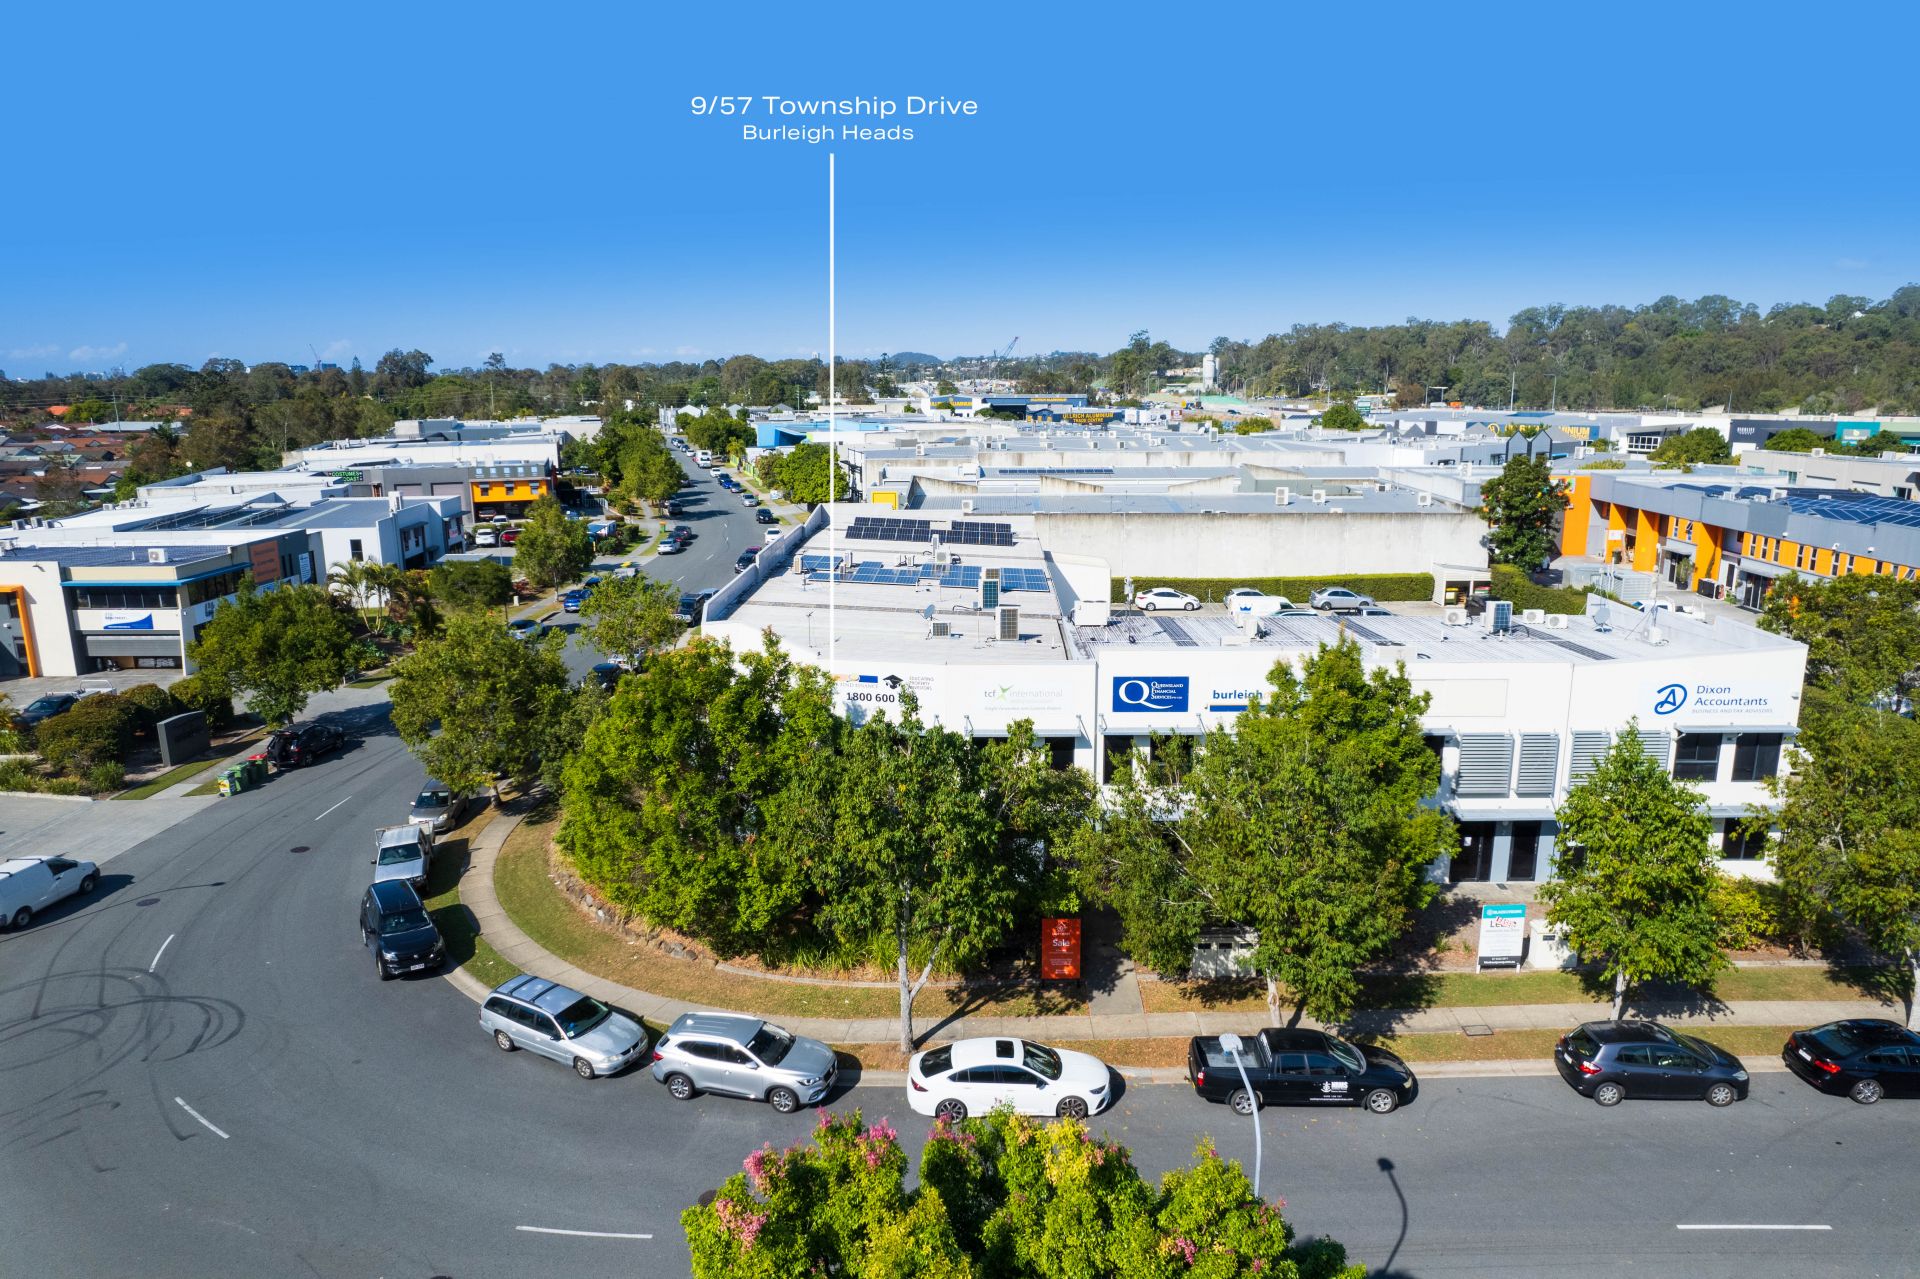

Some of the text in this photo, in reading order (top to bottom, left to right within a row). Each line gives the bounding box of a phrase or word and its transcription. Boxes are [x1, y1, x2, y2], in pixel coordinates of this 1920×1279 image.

[984, 688, 1063, 698] tcf international
[1696, 685, 1731, 694] Dixon
[846, 692, 872, 702] 1800
[875, 693, 895, 702] 600
[1694, 697, 1768, 706] Accountants
[1052, 938, 1070, 947] Sale
